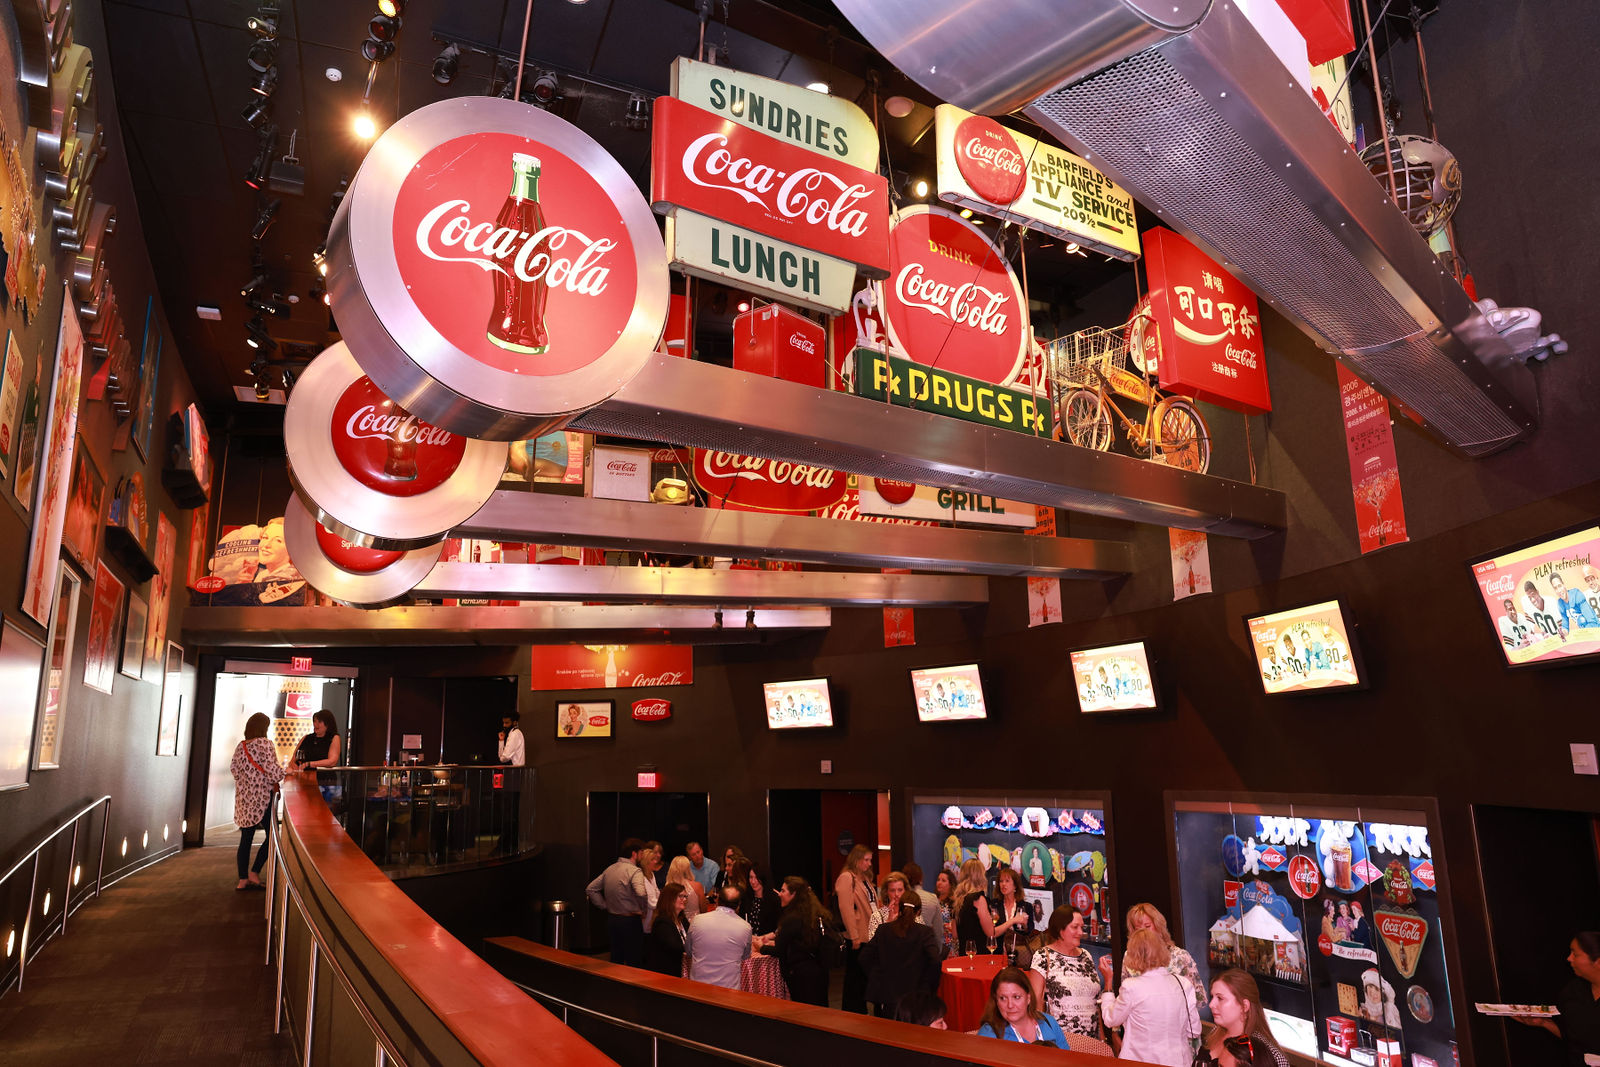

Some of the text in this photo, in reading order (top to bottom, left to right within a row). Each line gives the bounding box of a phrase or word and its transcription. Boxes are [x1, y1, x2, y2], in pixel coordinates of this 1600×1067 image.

[709, 78, 849, 157] SUNDRIES
[985, 130, 1003, 142] DRINK
[965, 137, 1022, 176] Coca-Cola
[1046, 153, 1114, 189] BARFIELD'S
[682, 132, 875, 238] Coca-Cola
[1031, 160, 1132, 211] APPLIANCE and
[1031, 176, 1135, 229] TV SERVICE
[415, 199, 618, 298] Coca-Cola
[711, 227, 821, 296] LUNCH
[928, 239, 974, 266] DRINK
[1201, 270, 1225, 295] 请喝
[895, 262, 1011, 336] Coca-Cola
[1173, 285, 1259, 340] 可口可乐
[789, 333, 815, 356] Coca-Cola
[1225, 342, 1257, 370] Coca-Cola
[908, 368, 1014, 424] DRUGS
[1342, 380, 1359, 394] 2006
[346, 405, 452, 446] Coca-Cola
[703, 449, 834, 489] CocaCola
[936, 488, 1006, 515] GRILL
[214, 546, 259, 558] REFRESHMENT
[225, 540, 252, 548] COOLING
[341, 540, 353, 550] Sign
[1534, 552, 1591, 581] PLAY refreshed
[1486, 573, 1515, 596] Coca-Cola
[1588, 596, 1600, 619] 8
[1533, 612, 1558, 636] 60
[294, 657, 310, 672] EXIT
[1325, 647, 1340, 664] 80
[634, 703, 667, 716] Coca-Cola
[1242, 887, 1273, 905] Coca-Cola
[1381, 917, 1420, 941] Coca-Cola
[1347, 949, 1373, 959] refreshed
